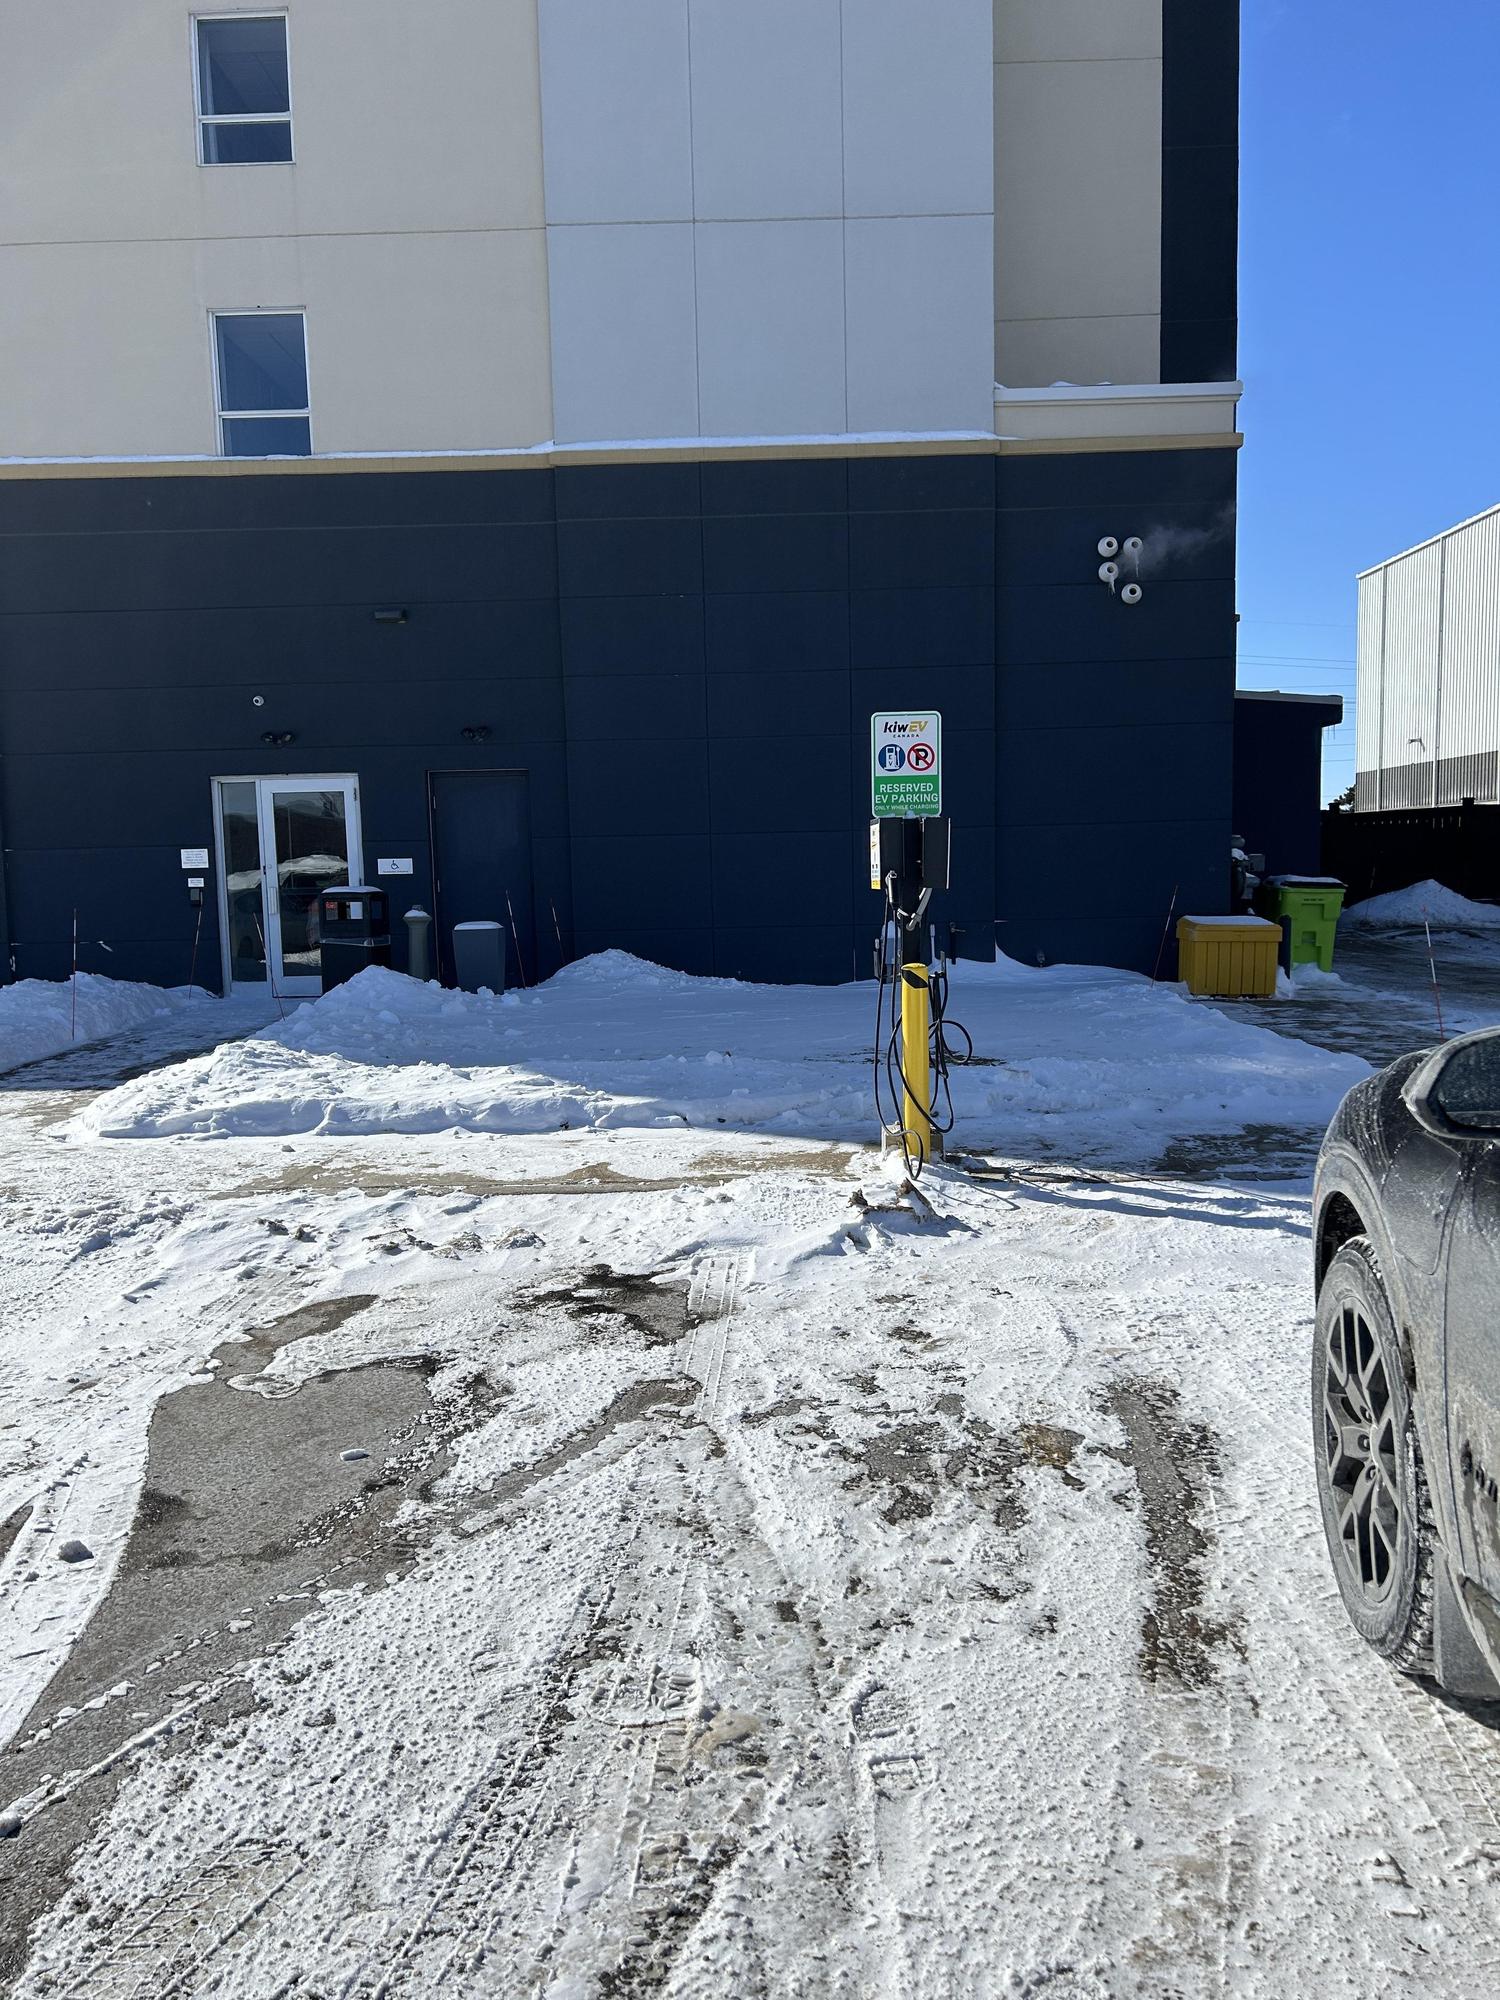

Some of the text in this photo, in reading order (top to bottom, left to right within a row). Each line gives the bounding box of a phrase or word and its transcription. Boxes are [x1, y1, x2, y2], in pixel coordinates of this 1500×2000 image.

[880, 783, 933, 793] RESERVED
[875, 793, 938, 803] EV PARKING
